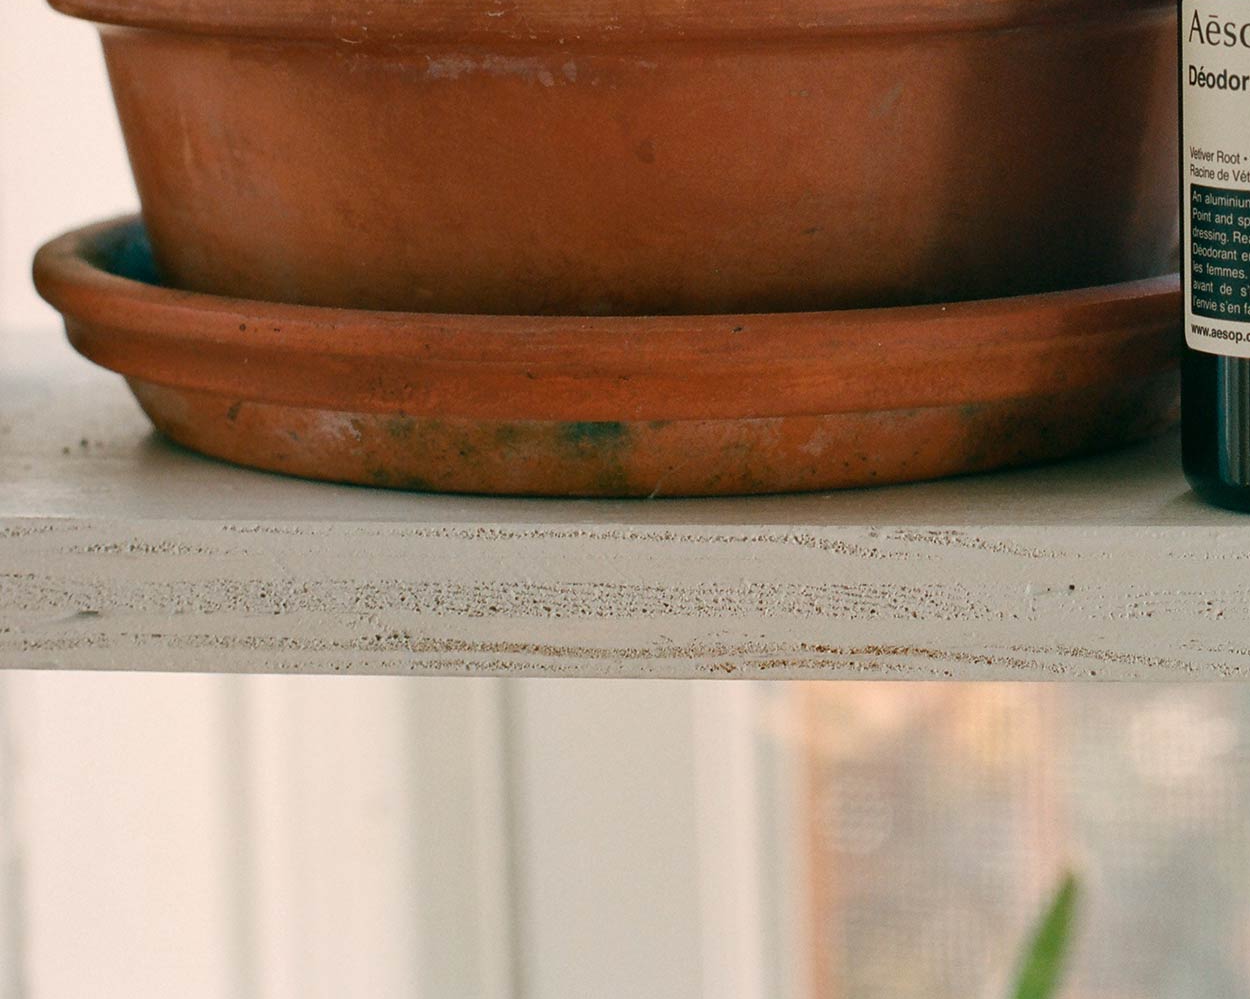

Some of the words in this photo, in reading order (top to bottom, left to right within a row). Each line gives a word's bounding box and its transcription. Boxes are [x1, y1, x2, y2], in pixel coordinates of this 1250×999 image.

[1190, 145, 1214, 162] Vetiver
[1217, 150, 1240, 164] Root
[1190, 164, 1215, 180] Racine
[1217, 169, 1229, 181] de
[1192, 190, 1202, 203] An
[1192, 207, 1212, 222] Point
[1214, 212, 1234, 226] and
[1192, 226, 1230, 245] dressing.
[1192, 260, 1204, 274] les
[1206, 262, 1248, 280] femmes.
[1192, 279, 1214, 293] avant
[1219, 283, 1233, 296] de
